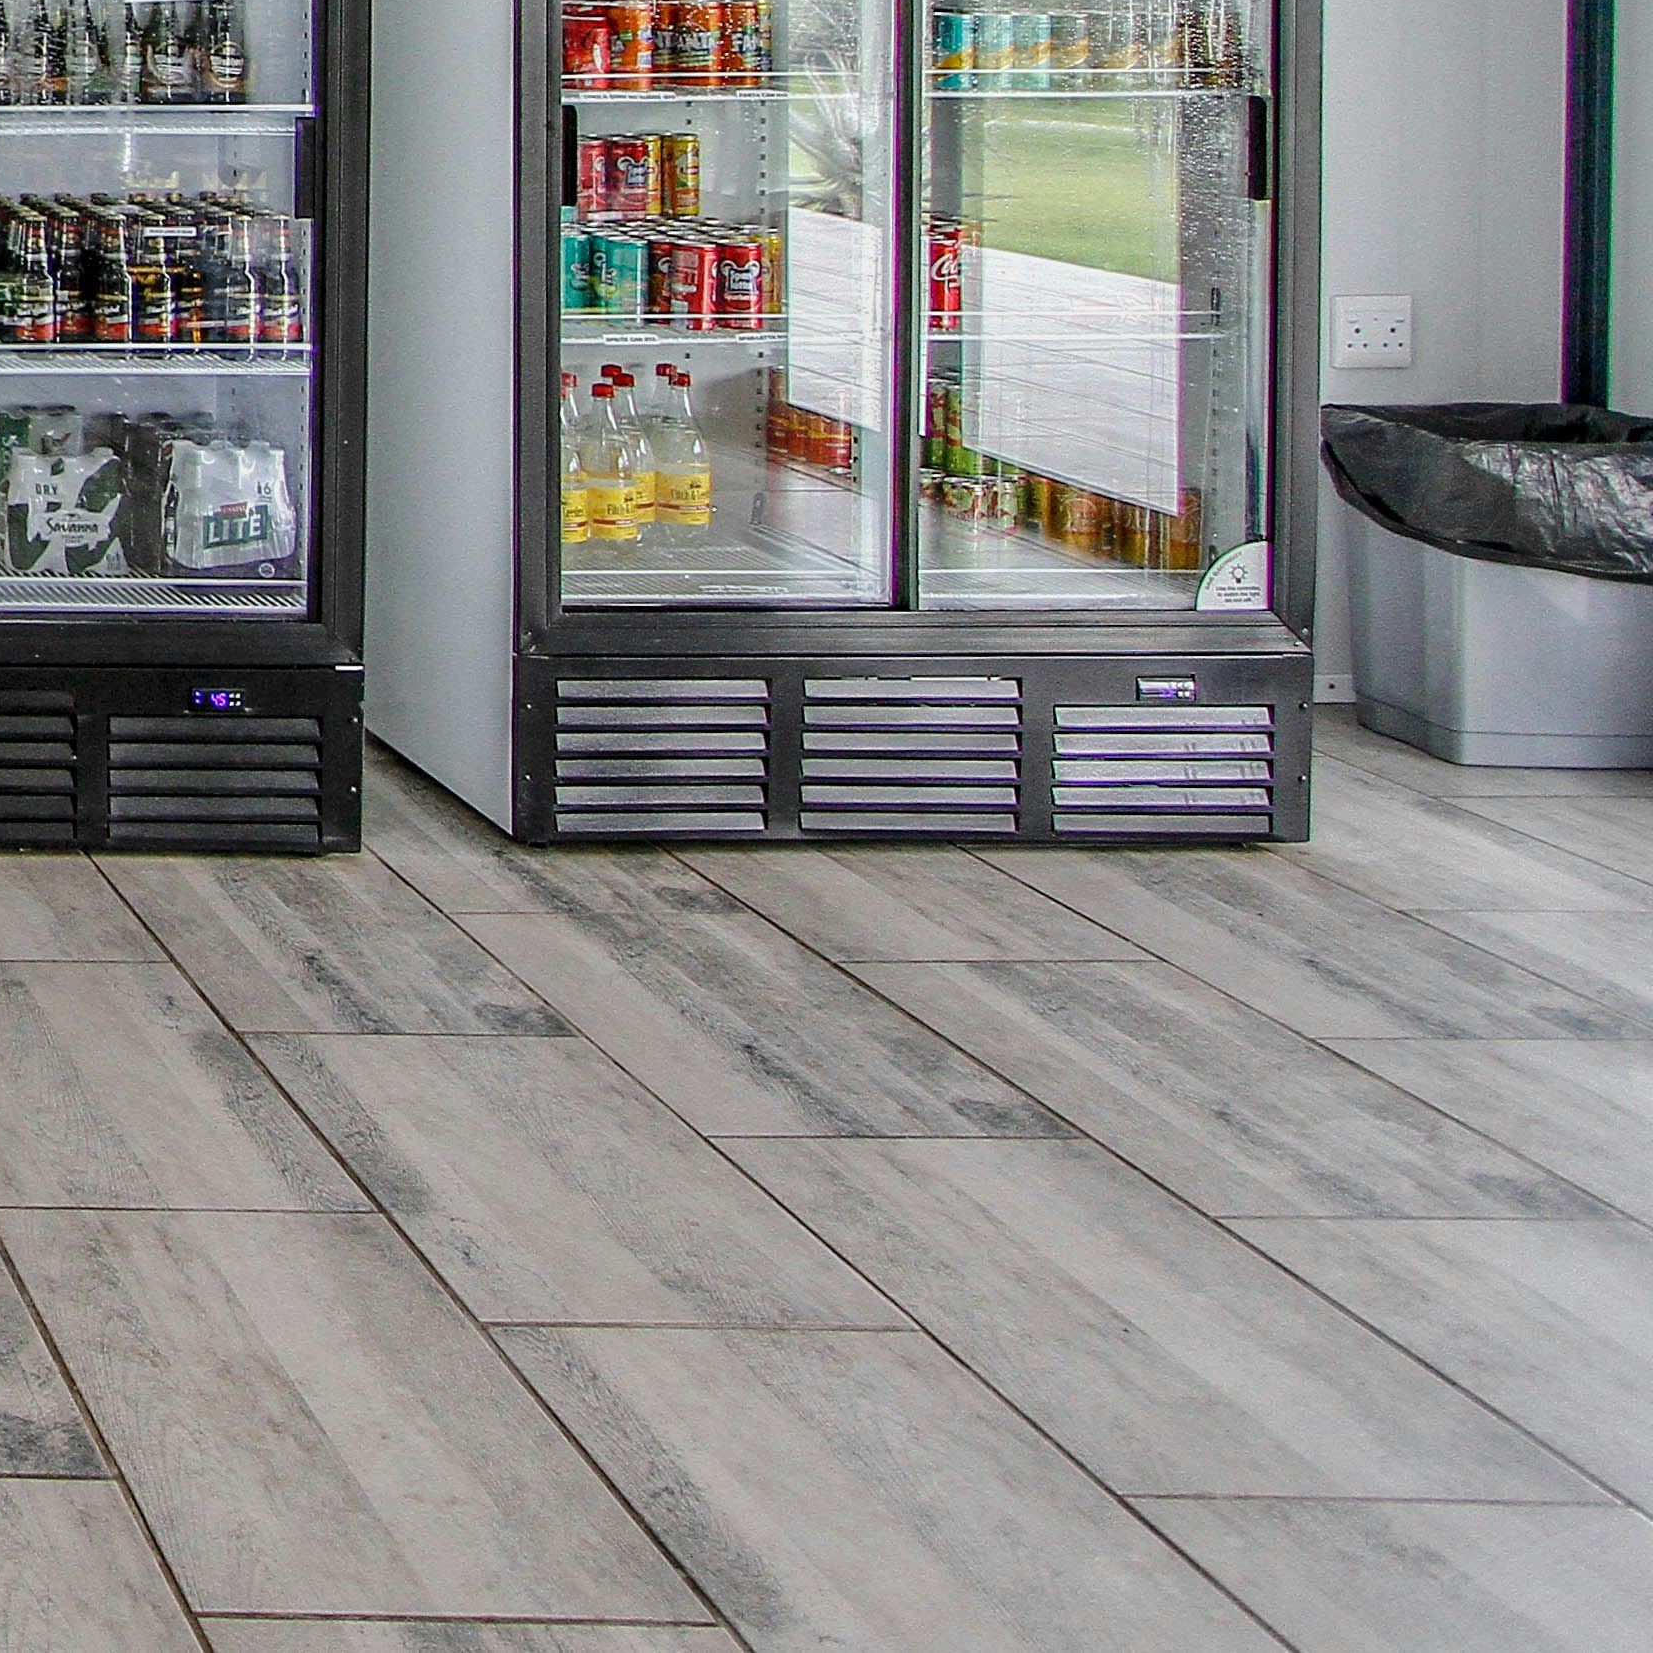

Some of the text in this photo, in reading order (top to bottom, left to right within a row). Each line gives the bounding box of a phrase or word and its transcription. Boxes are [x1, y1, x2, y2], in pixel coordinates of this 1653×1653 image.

[35, 482, 58, 496] DRY
[46, 517, 99, 536] Savanna
[208, 513, 262, 544] LITE
